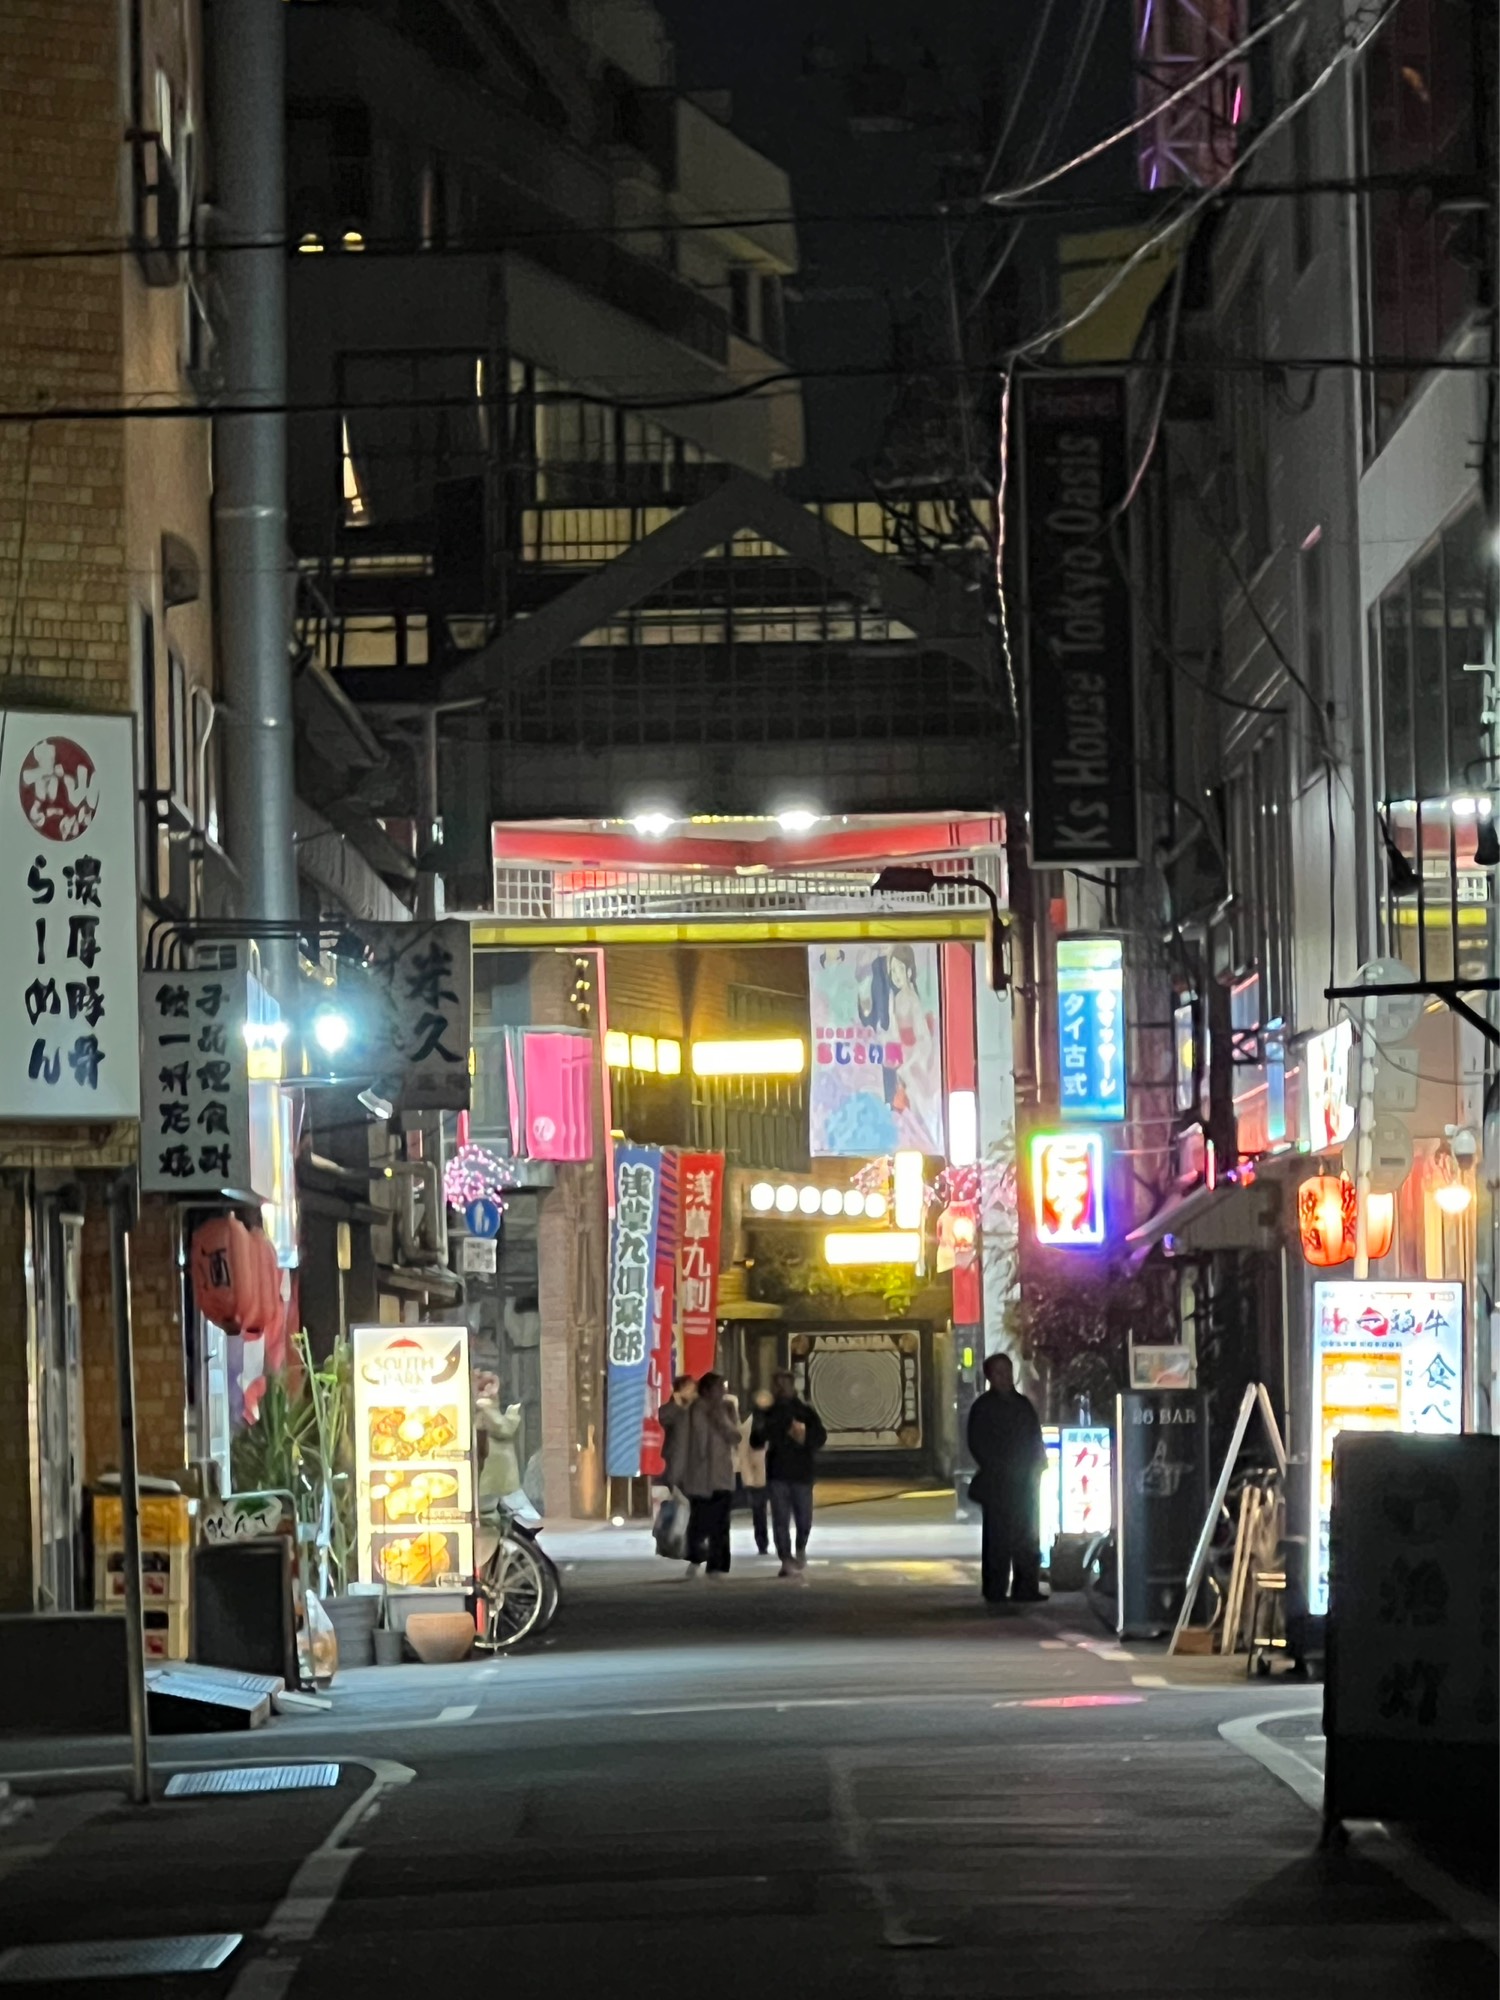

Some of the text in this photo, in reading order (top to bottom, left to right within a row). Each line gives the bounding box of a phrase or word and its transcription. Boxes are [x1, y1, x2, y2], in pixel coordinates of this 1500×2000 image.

[1045, 432, 1101, 534] Oasis
[1050, 546, 1110, 658] Tokyo
[1052, 671, 1110, 786] House
[25, 853, 60, 1086] らーめん
[1063, 993, 1087, 1096] タイ古式
[374, 1356, 434, 1371] SOUTH
[1159, 1408, 1197, 1425] BAR
